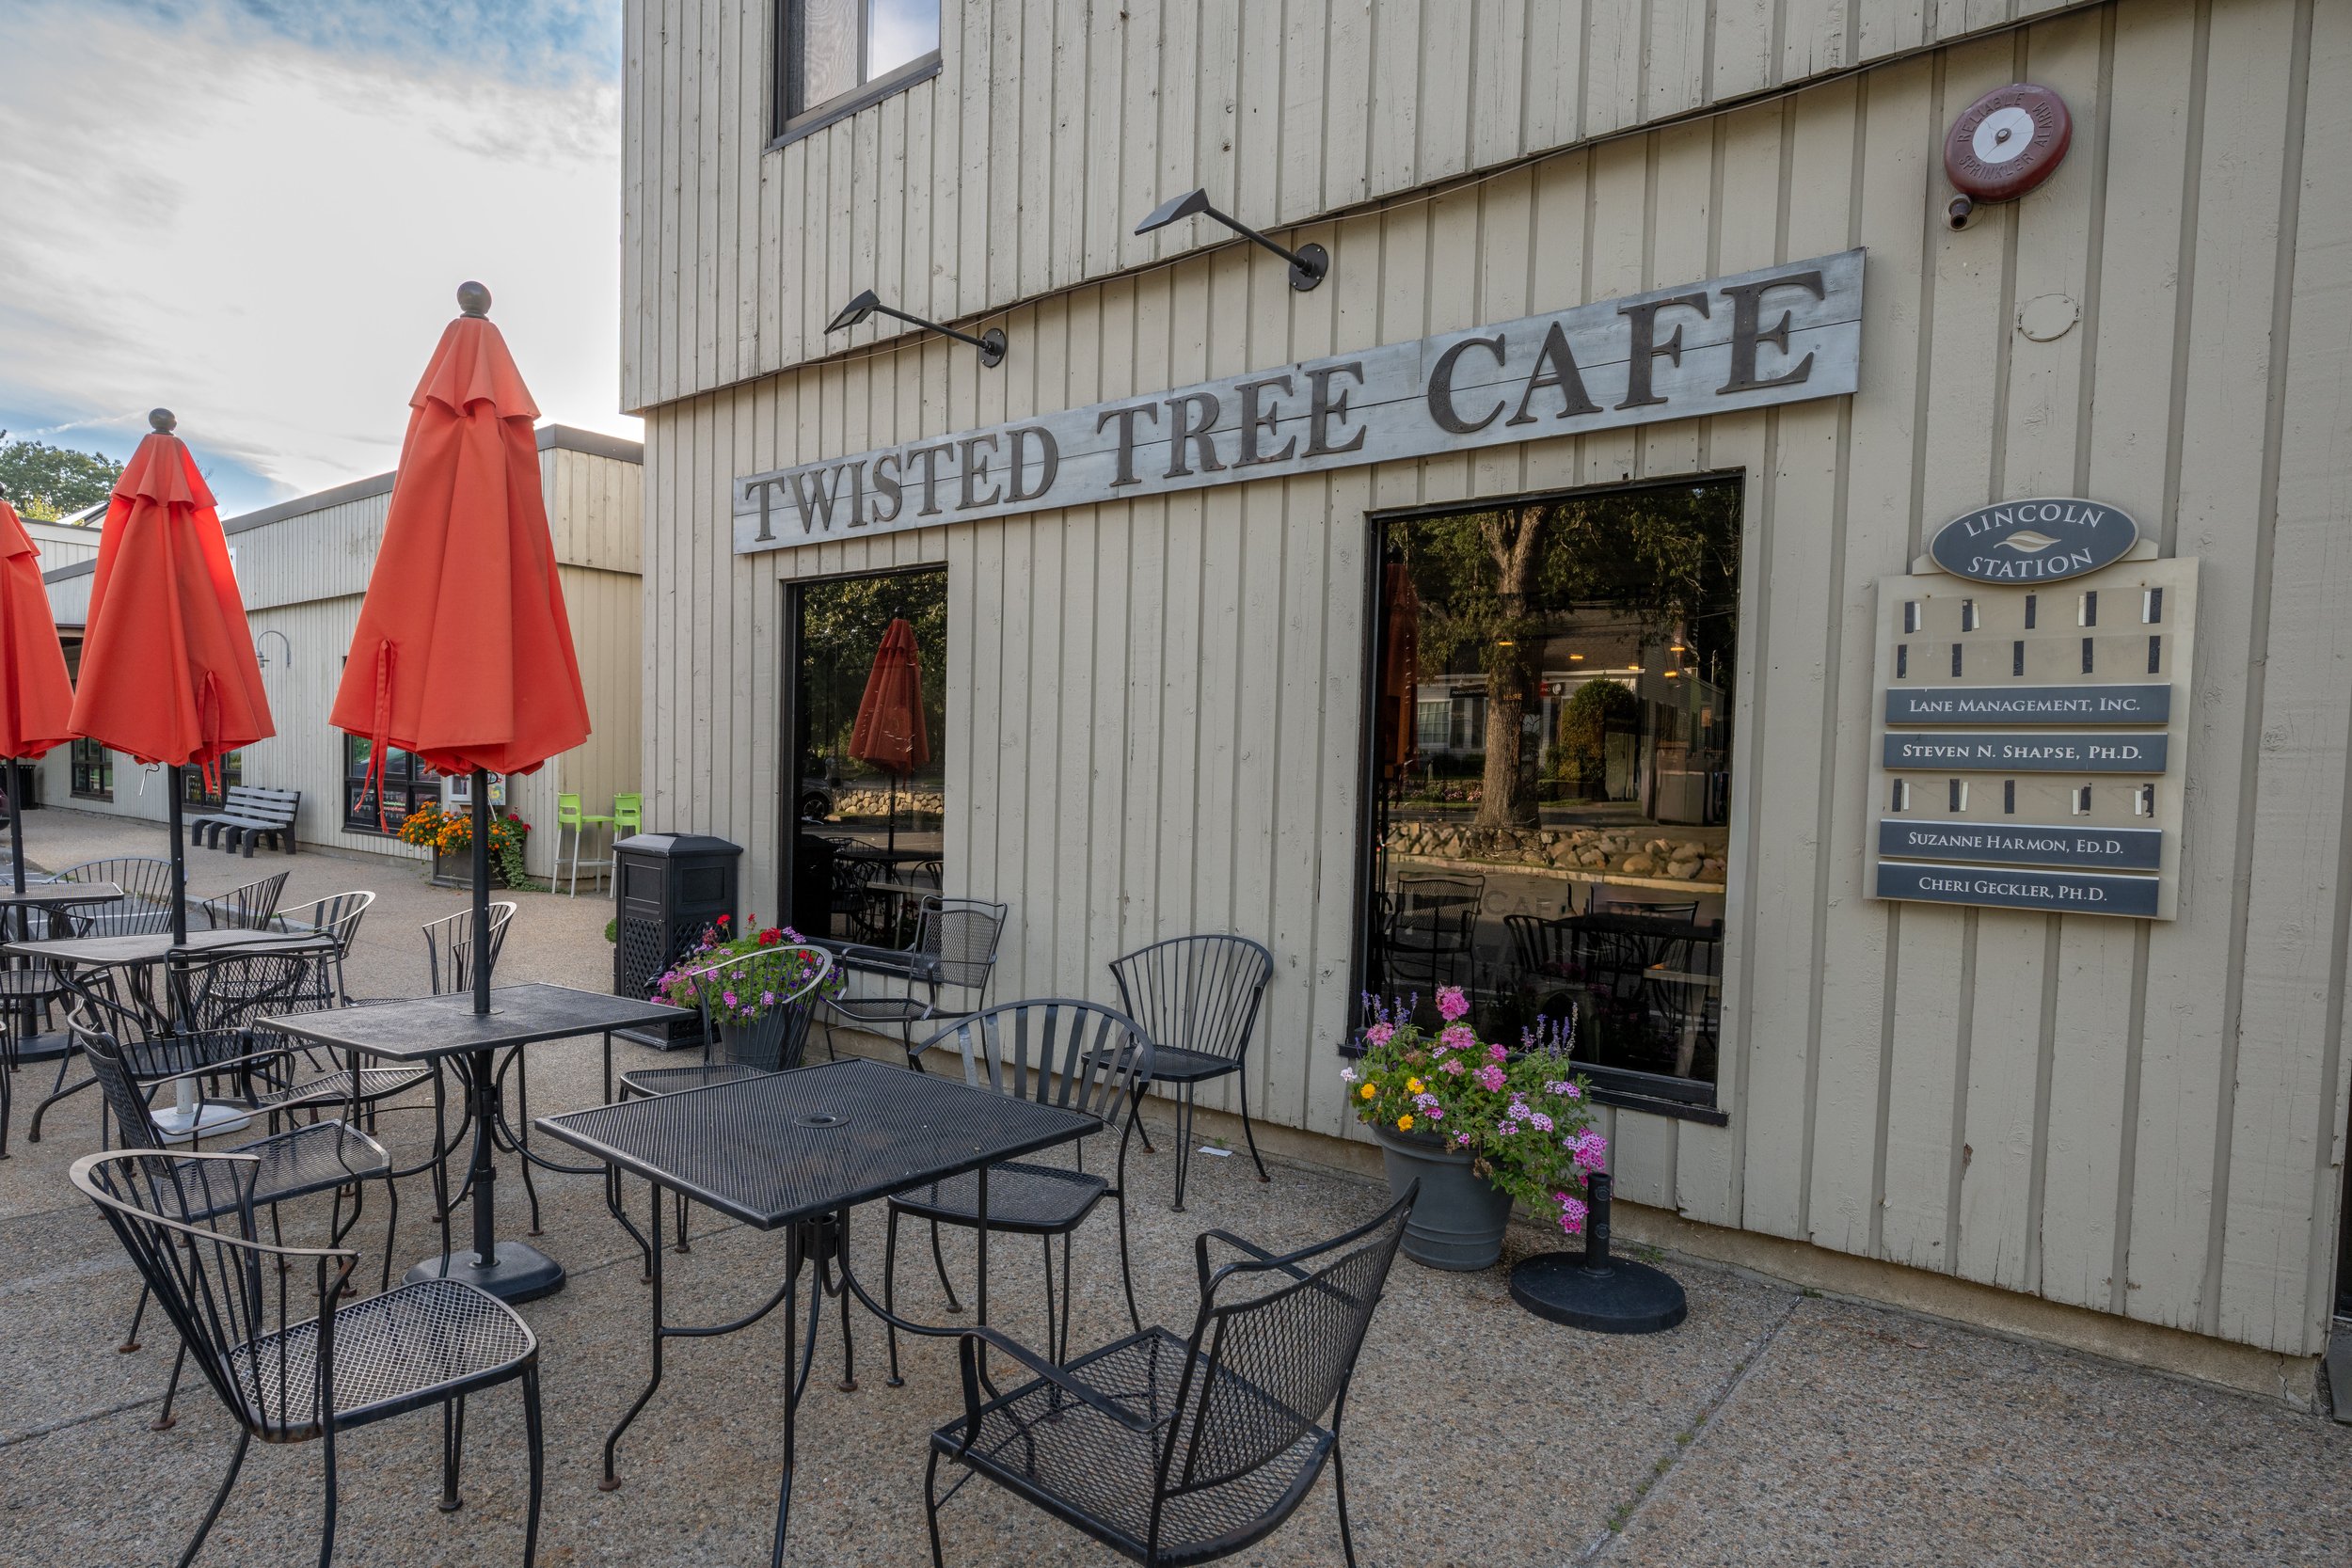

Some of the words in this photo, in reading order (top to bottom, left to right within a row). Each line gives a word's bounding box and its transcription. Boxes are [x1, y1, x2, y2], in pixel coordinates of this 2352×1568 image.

[1957, 92, 2026, 143] RELIABLE
[1959, 152, 2035, 181] SPRINKLER
[744, 424, 1059, 542] TWISTED
[1096, 360, 1367, 488] TREE
[1428, 269, 1826, 434] CAFE
[1963, 502, 2106, 538] LINCOLN
[1966, 547, 2093, 578] STATION
[1976, 745, 1996, 758] N.
